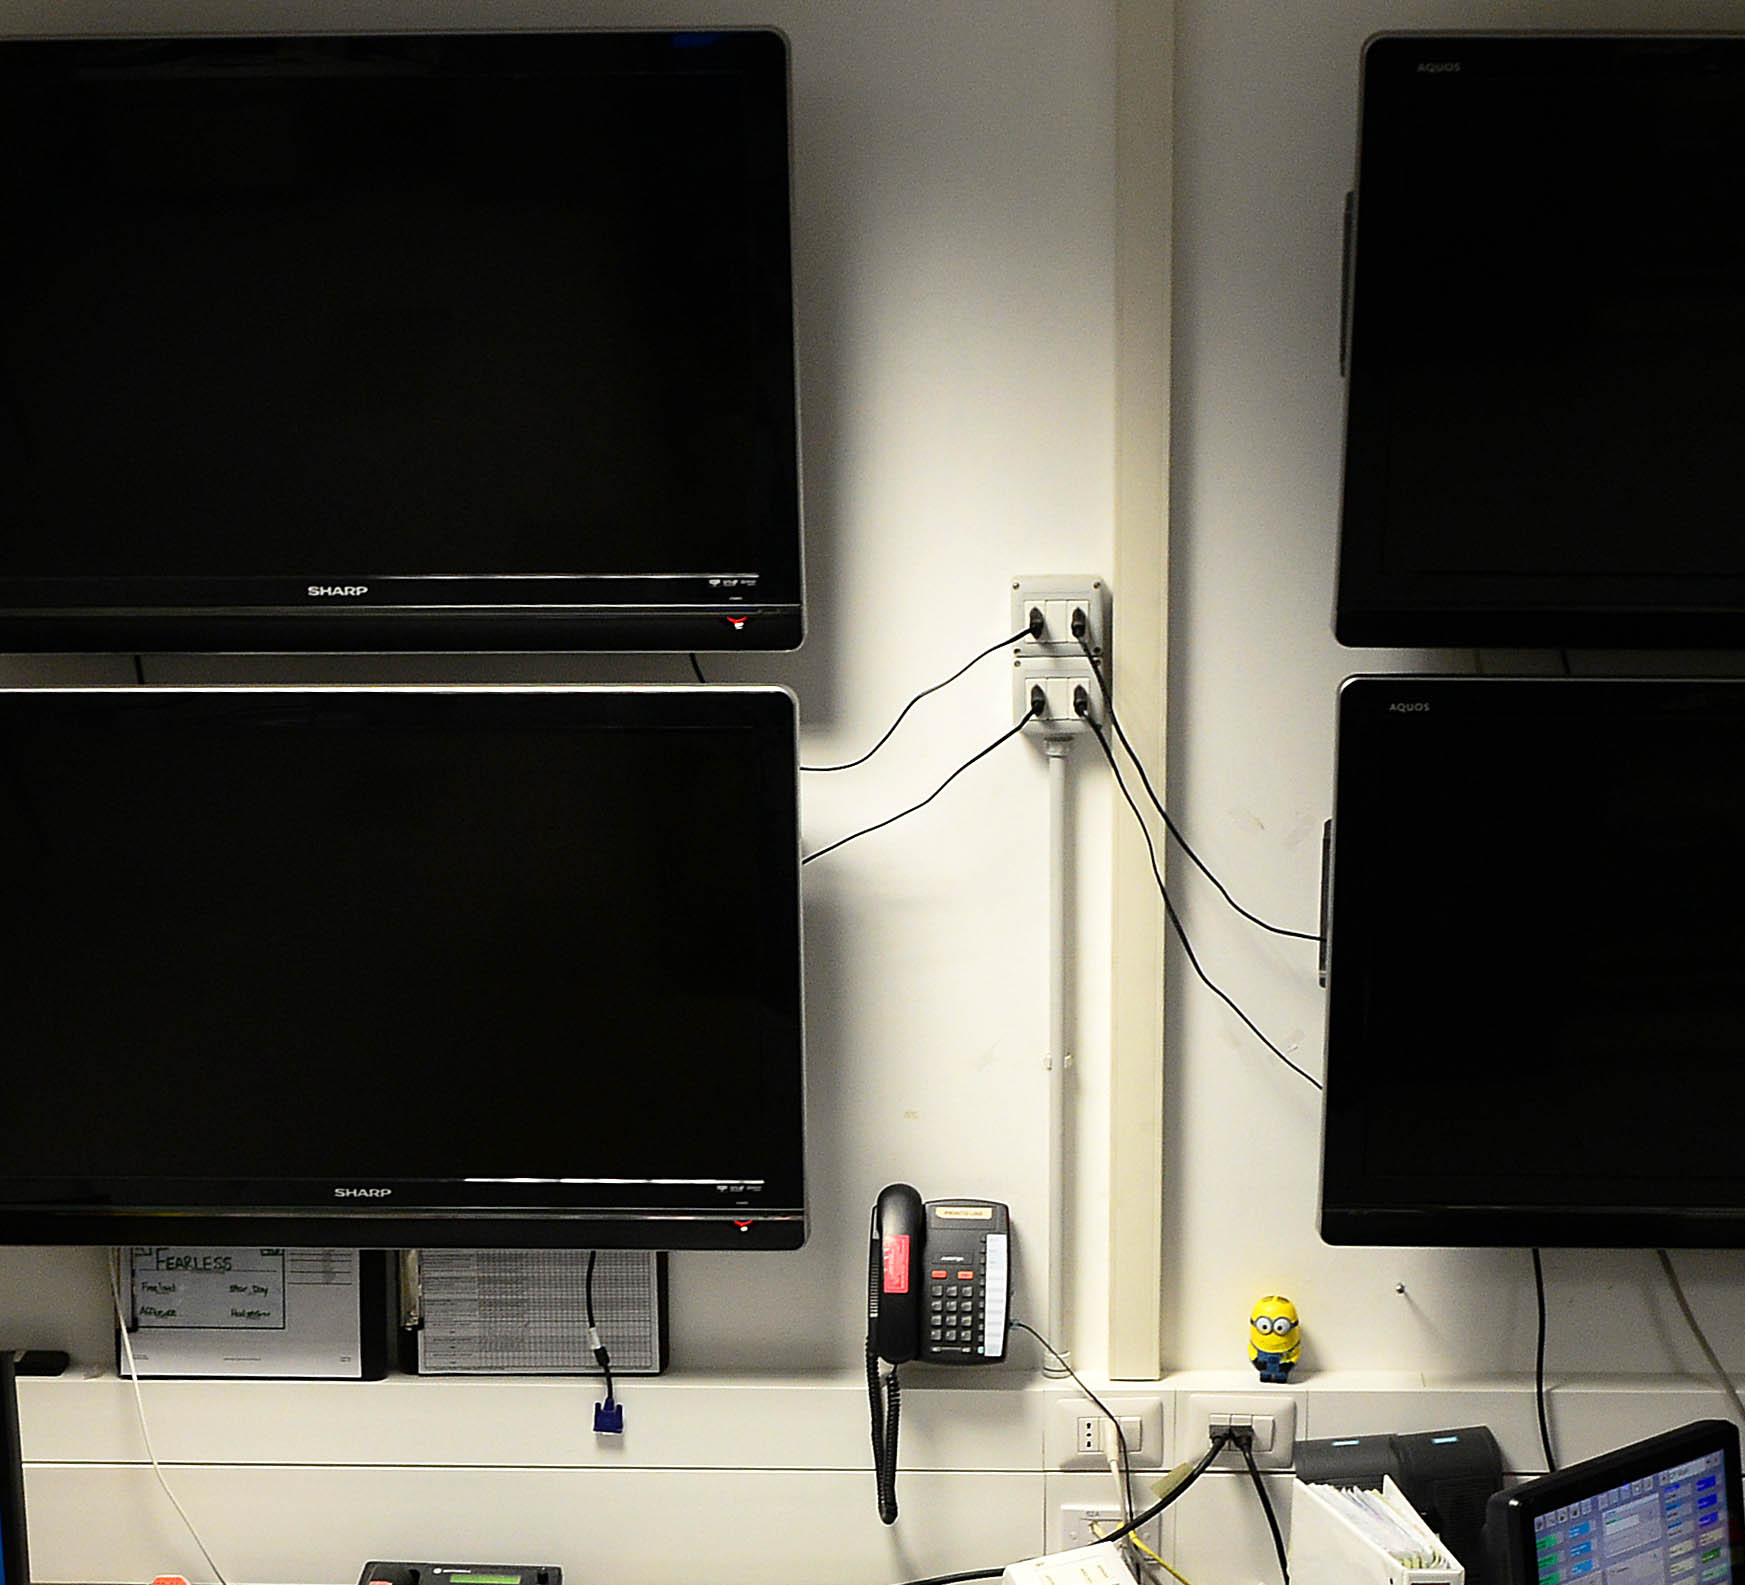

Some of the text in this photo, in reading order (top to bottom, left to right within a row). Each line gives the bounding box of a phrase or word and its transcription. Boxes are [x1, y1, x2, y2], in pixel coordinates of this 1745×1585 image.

[307, 586, 369, 597] SHARP
[1388, 702, 1431, 714] AQUOS
[334, 1188, 393, 1198] SHARP
[155, 1248, 233, 1272] FEARLESS
